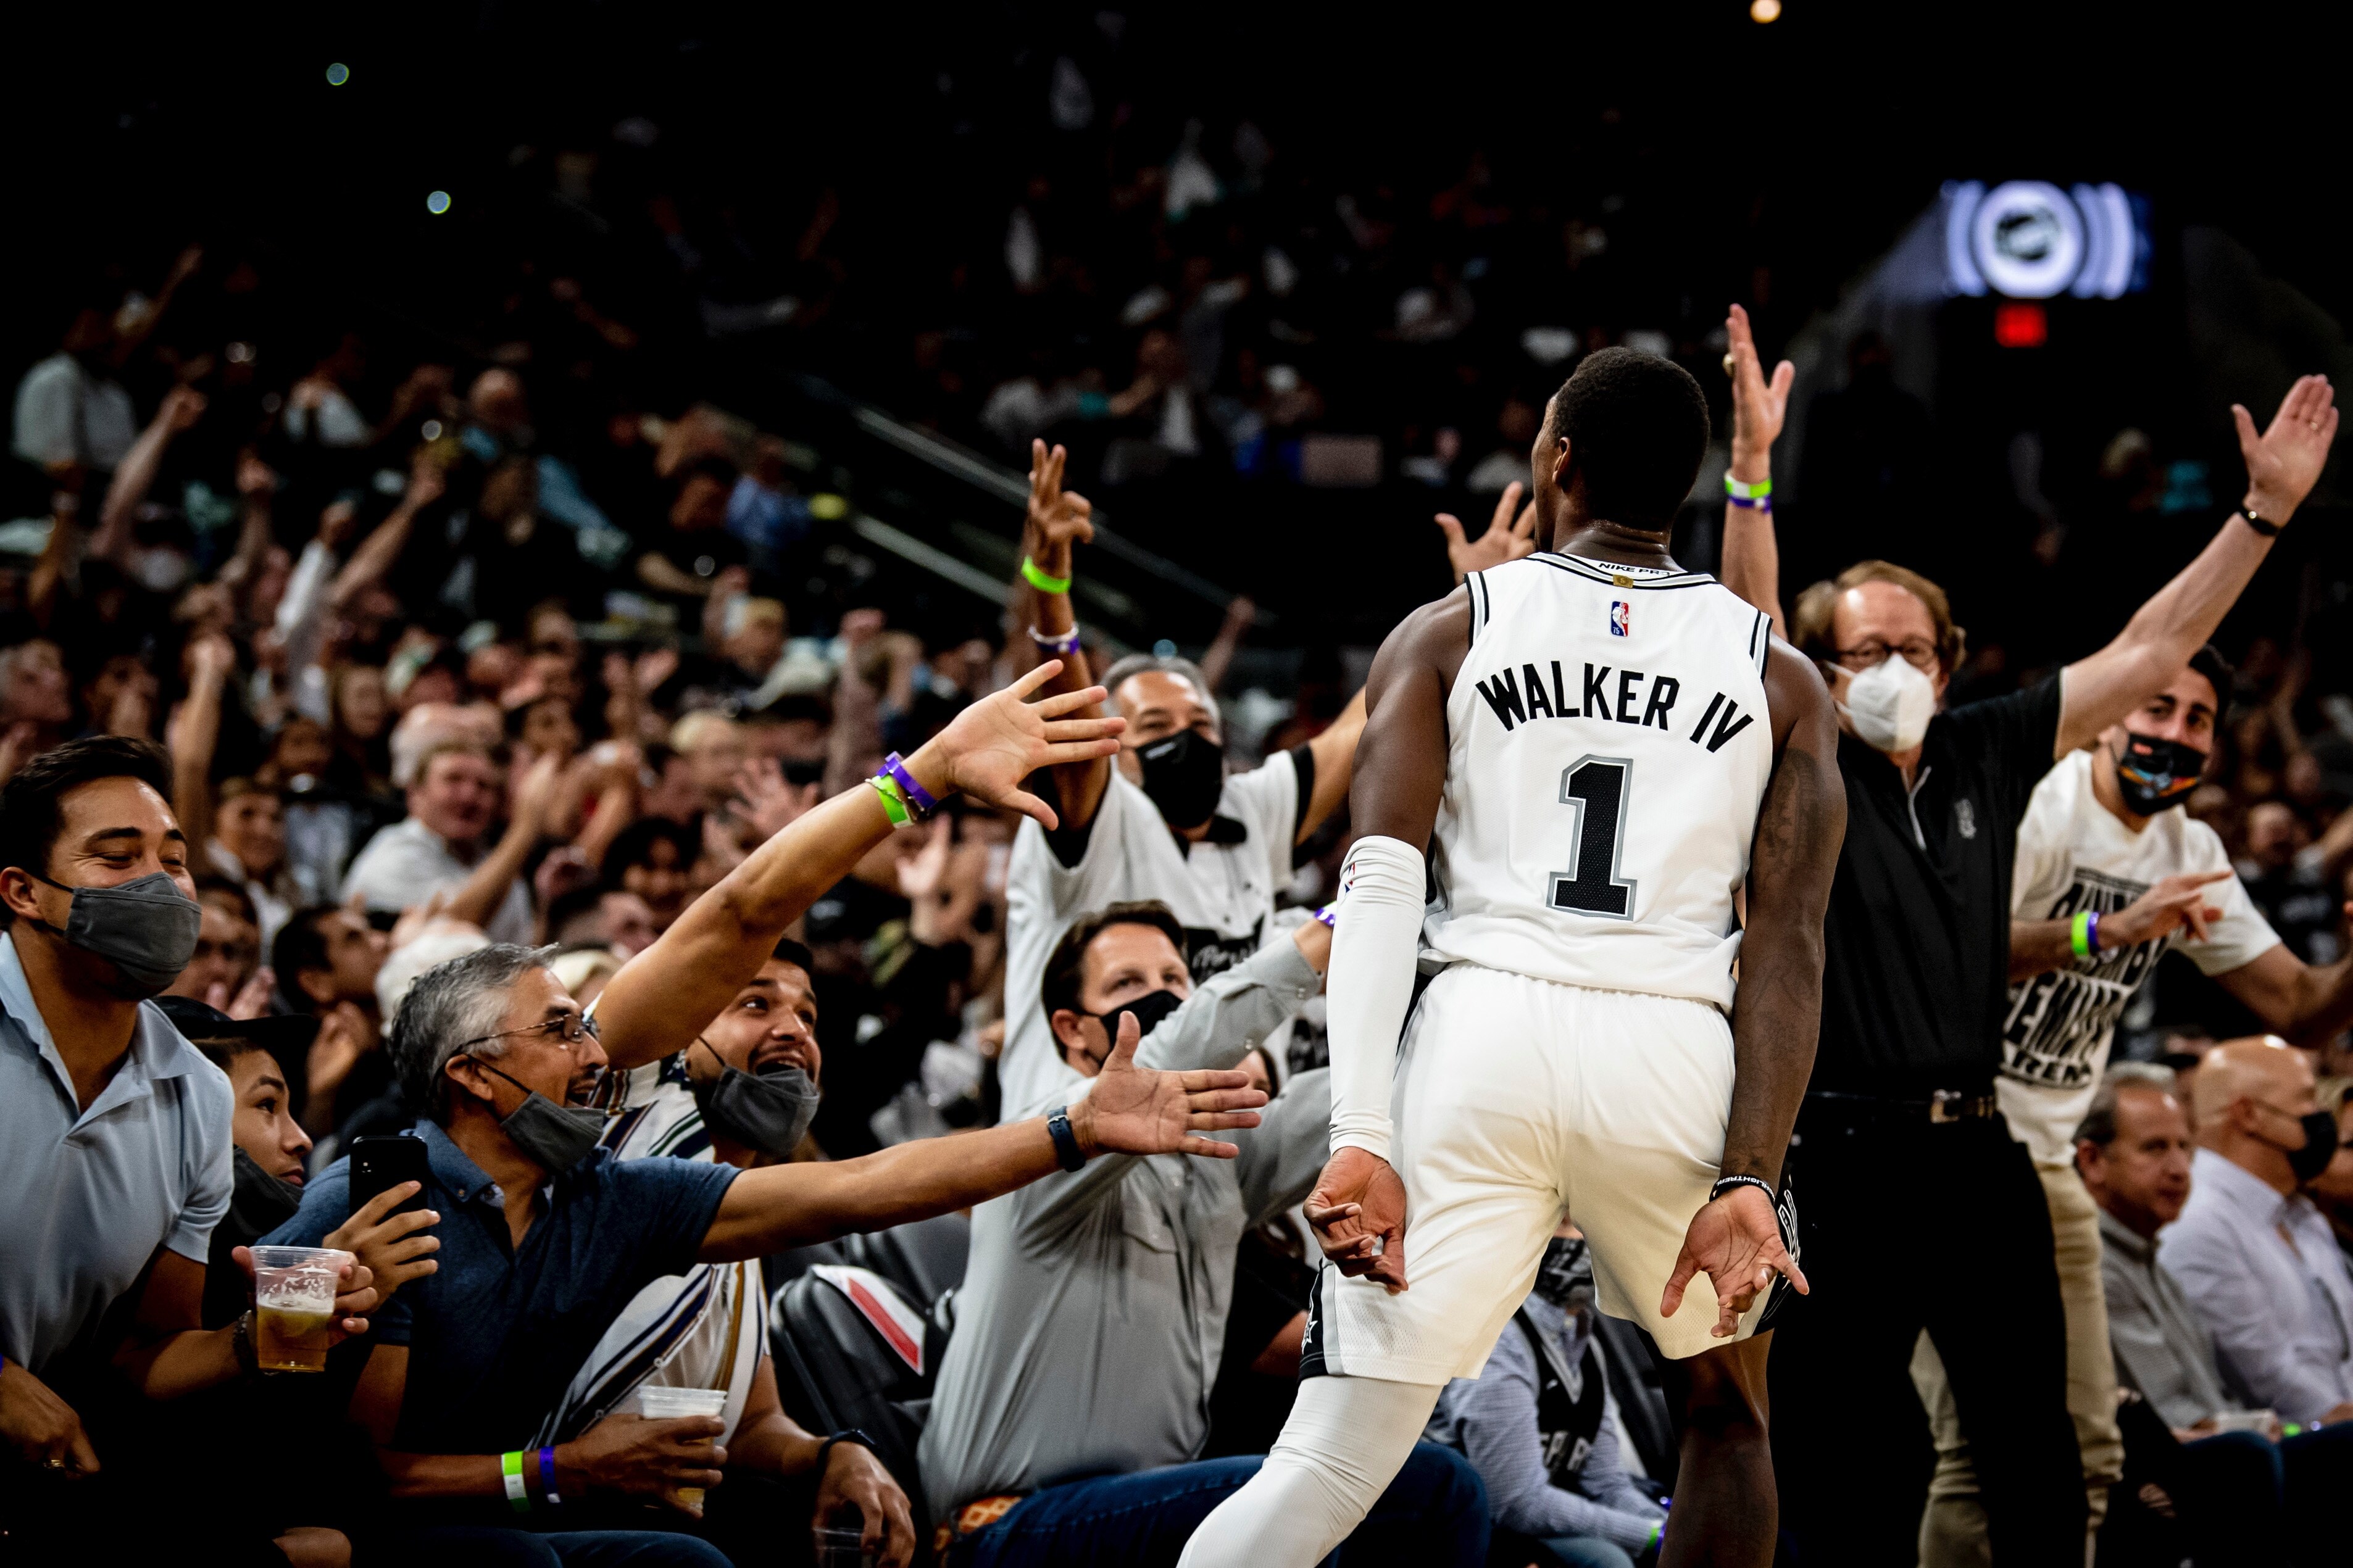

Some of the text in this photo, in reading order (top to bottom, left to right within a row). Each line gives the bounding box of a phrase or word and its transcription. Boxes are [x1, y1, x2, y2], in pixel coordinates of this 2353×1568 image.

[1599, 563, 1635, 572] NIKE
[1613, 626, 1620, 635] 75
[1475, 660, 1754, 753] WALKER IV
[1546, 753, 1638, 921] 1
